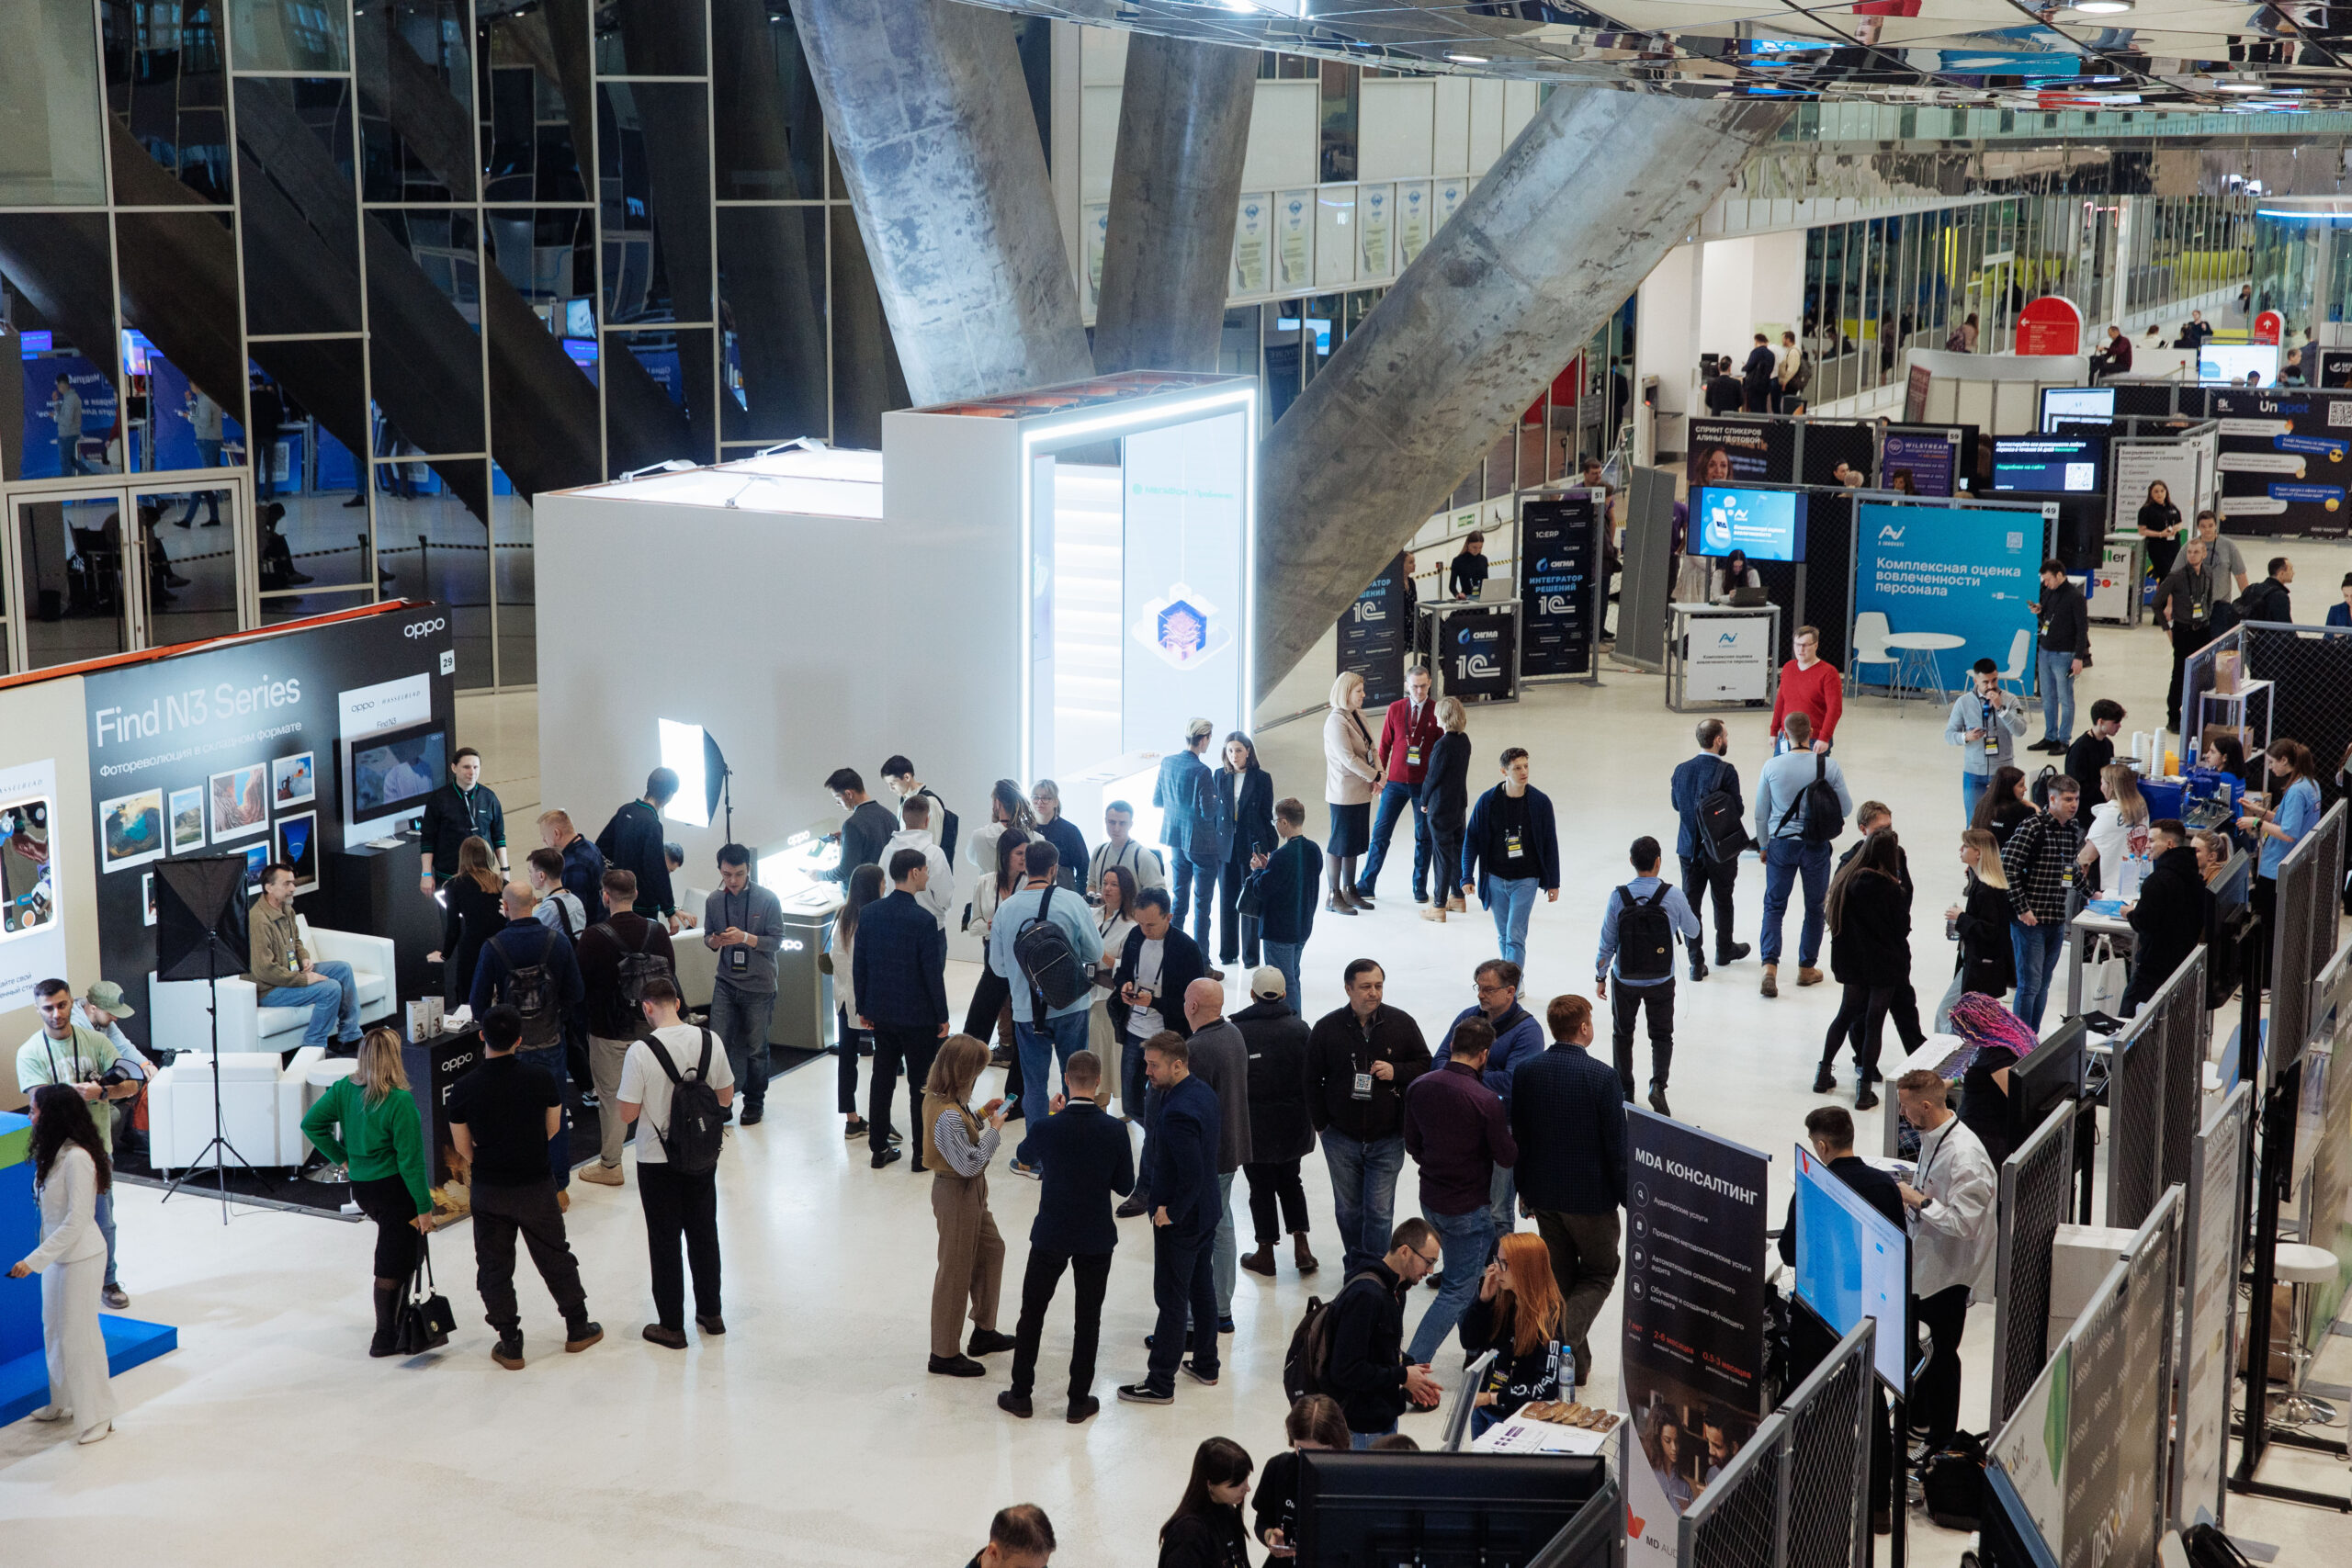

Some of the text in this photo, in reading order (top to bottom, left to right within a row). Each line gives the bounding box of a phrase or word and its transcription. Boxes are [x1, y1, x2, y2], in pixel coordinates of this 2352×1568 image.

[2259, 400, 2309, 415] UnSpot
[1695, 425, 1762, 436] СПРИНТ СПИКЕРОВ
[1905, 442, 1949, 450] WILSTREAM
[1595, 491, 1602, 500] 51
[1876, 558, 2021, 577] Комплексная оценка
[1529, 574, 1583, 585] ИНТЕГРАТОР
[1876, 570, 1981, 587] вовлеченности
[1359, 588, 1385, 599] ШЕНИЙ
[1535, 583, 1577, 593] РЕШЕНИЙ
[1875, 581, 1948, 596] персонала
[404, 617, 446, 639] oppo
[443, 657, 454, 668] 29
[96, 674, 301, 748] Find N3 Series
[351, 691, 422, 714] oppo HASSELBLAD
[377, 717, 397, 728] Find N3
[99, 722, 302, 777] Фотореволюция в складном формате
[441, 1053, 473, 1072] oppo
[1666, 1159, 1758, 1205] КОНСАЛТИНГ
[1654, 1196, 1709, 1224] Аудиторские услуги
[1652, 1227, 1752, 1273] Проектно-методологические услуги
[1651, 1265, 1670, 1277] аудита
[1652, 1255, 1736, 1295] Автоматизация операционного
[1650, 1296, 1676, 1310] контента
[1650, 1285, 1678, 1303] Обучение
[1683, 1301, 1710, 1315] создание
[1710, 1310, 1745, 1330] обучающего
[1667, 1337, 1694, 1355] месяцев
[1722, 1361, 1752, 1380] месяцев
[1646, 1535, 1659, 1549] MD
